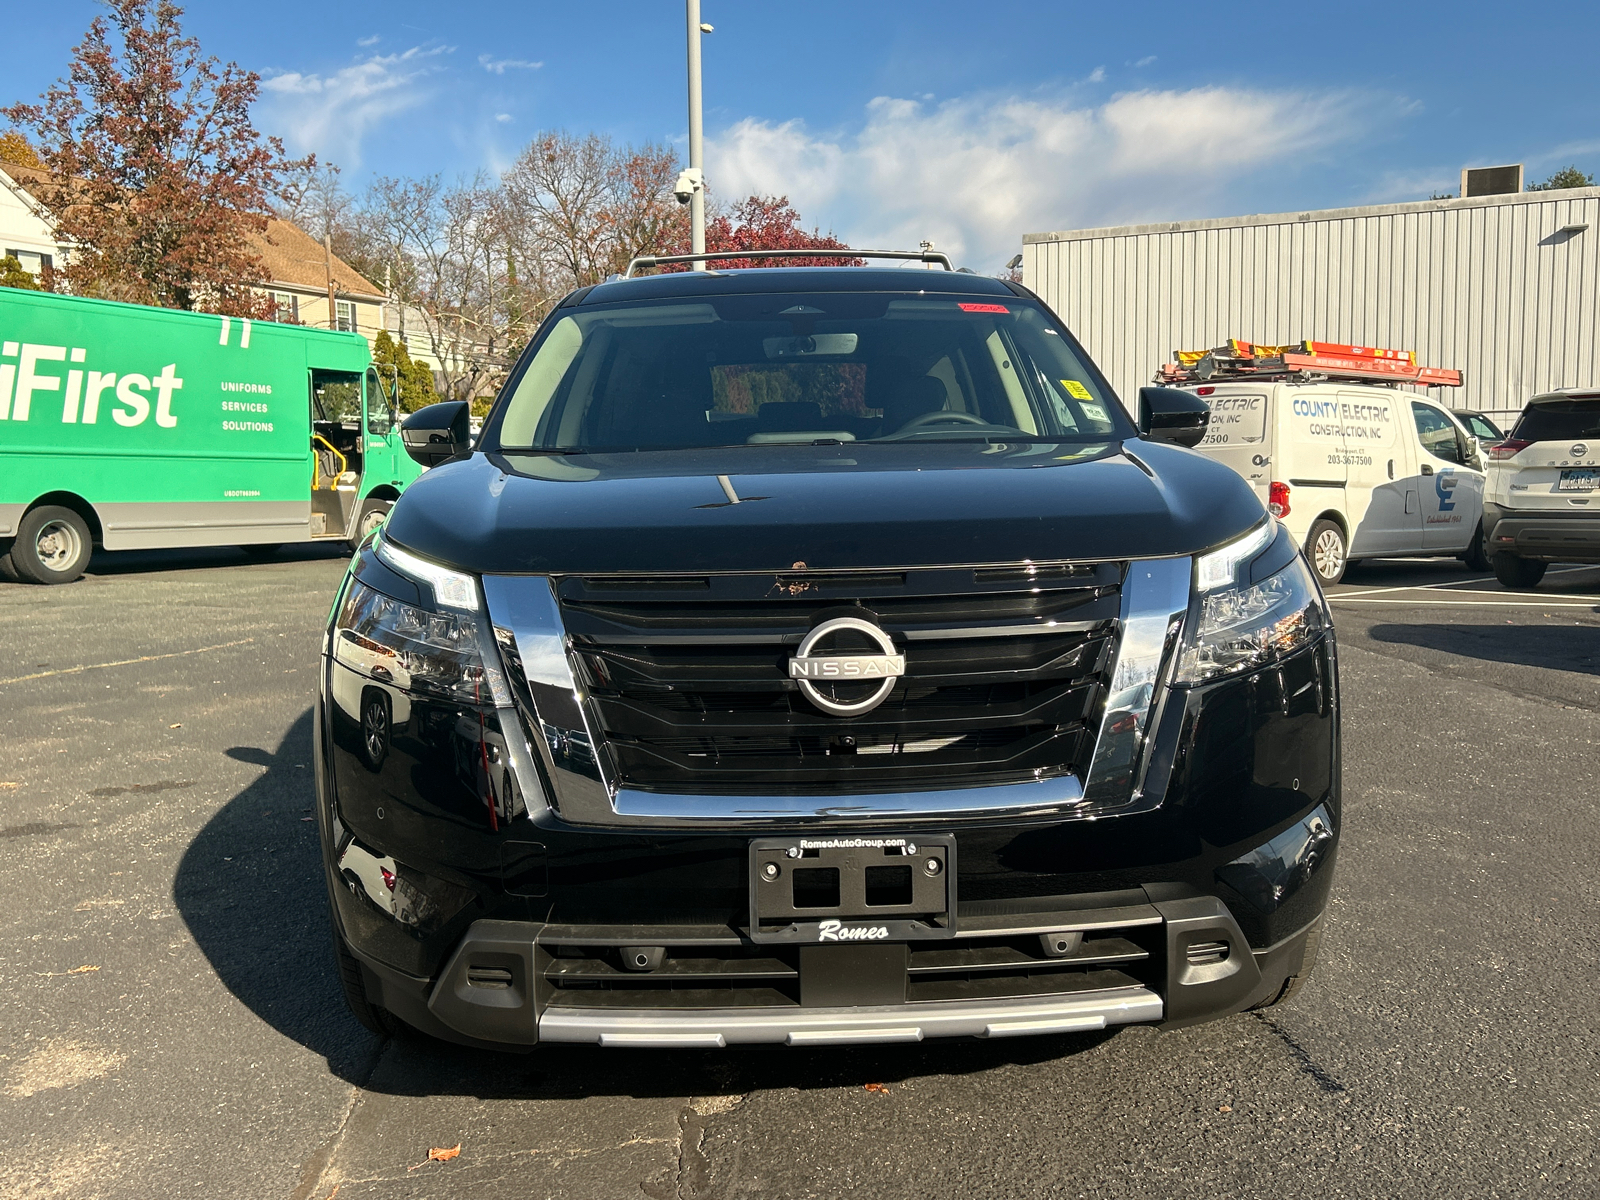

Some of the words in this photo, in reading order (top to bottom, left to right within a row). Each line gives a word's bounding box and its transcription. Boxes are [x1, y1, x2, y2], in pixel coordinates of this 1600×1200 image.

[221, 381, 272, 394] UNIFORMS
[221, 401, 268, 413] SERVICES
[1205, 398, 1261, 411] LECTRIC
[1293, 399, 1338, 418] COUNTY
[1341, 403, 1390, 423] ELECTRIC
[1226, 414, 1241, 423] INC
[222, 420, 274, 432] SOLUTIONS
[1309, 423, 1369, 439] CONSTRUCTION,
[1369, 427, 1382, 439] INC
[1327, 454, 1373, 466] 203-367-7500
[791, 660, 901, 677] NISSAN
[800, 838, 906, 849] RomeoAutoGroup.com
[819, 919, 889, 942] Romeo
